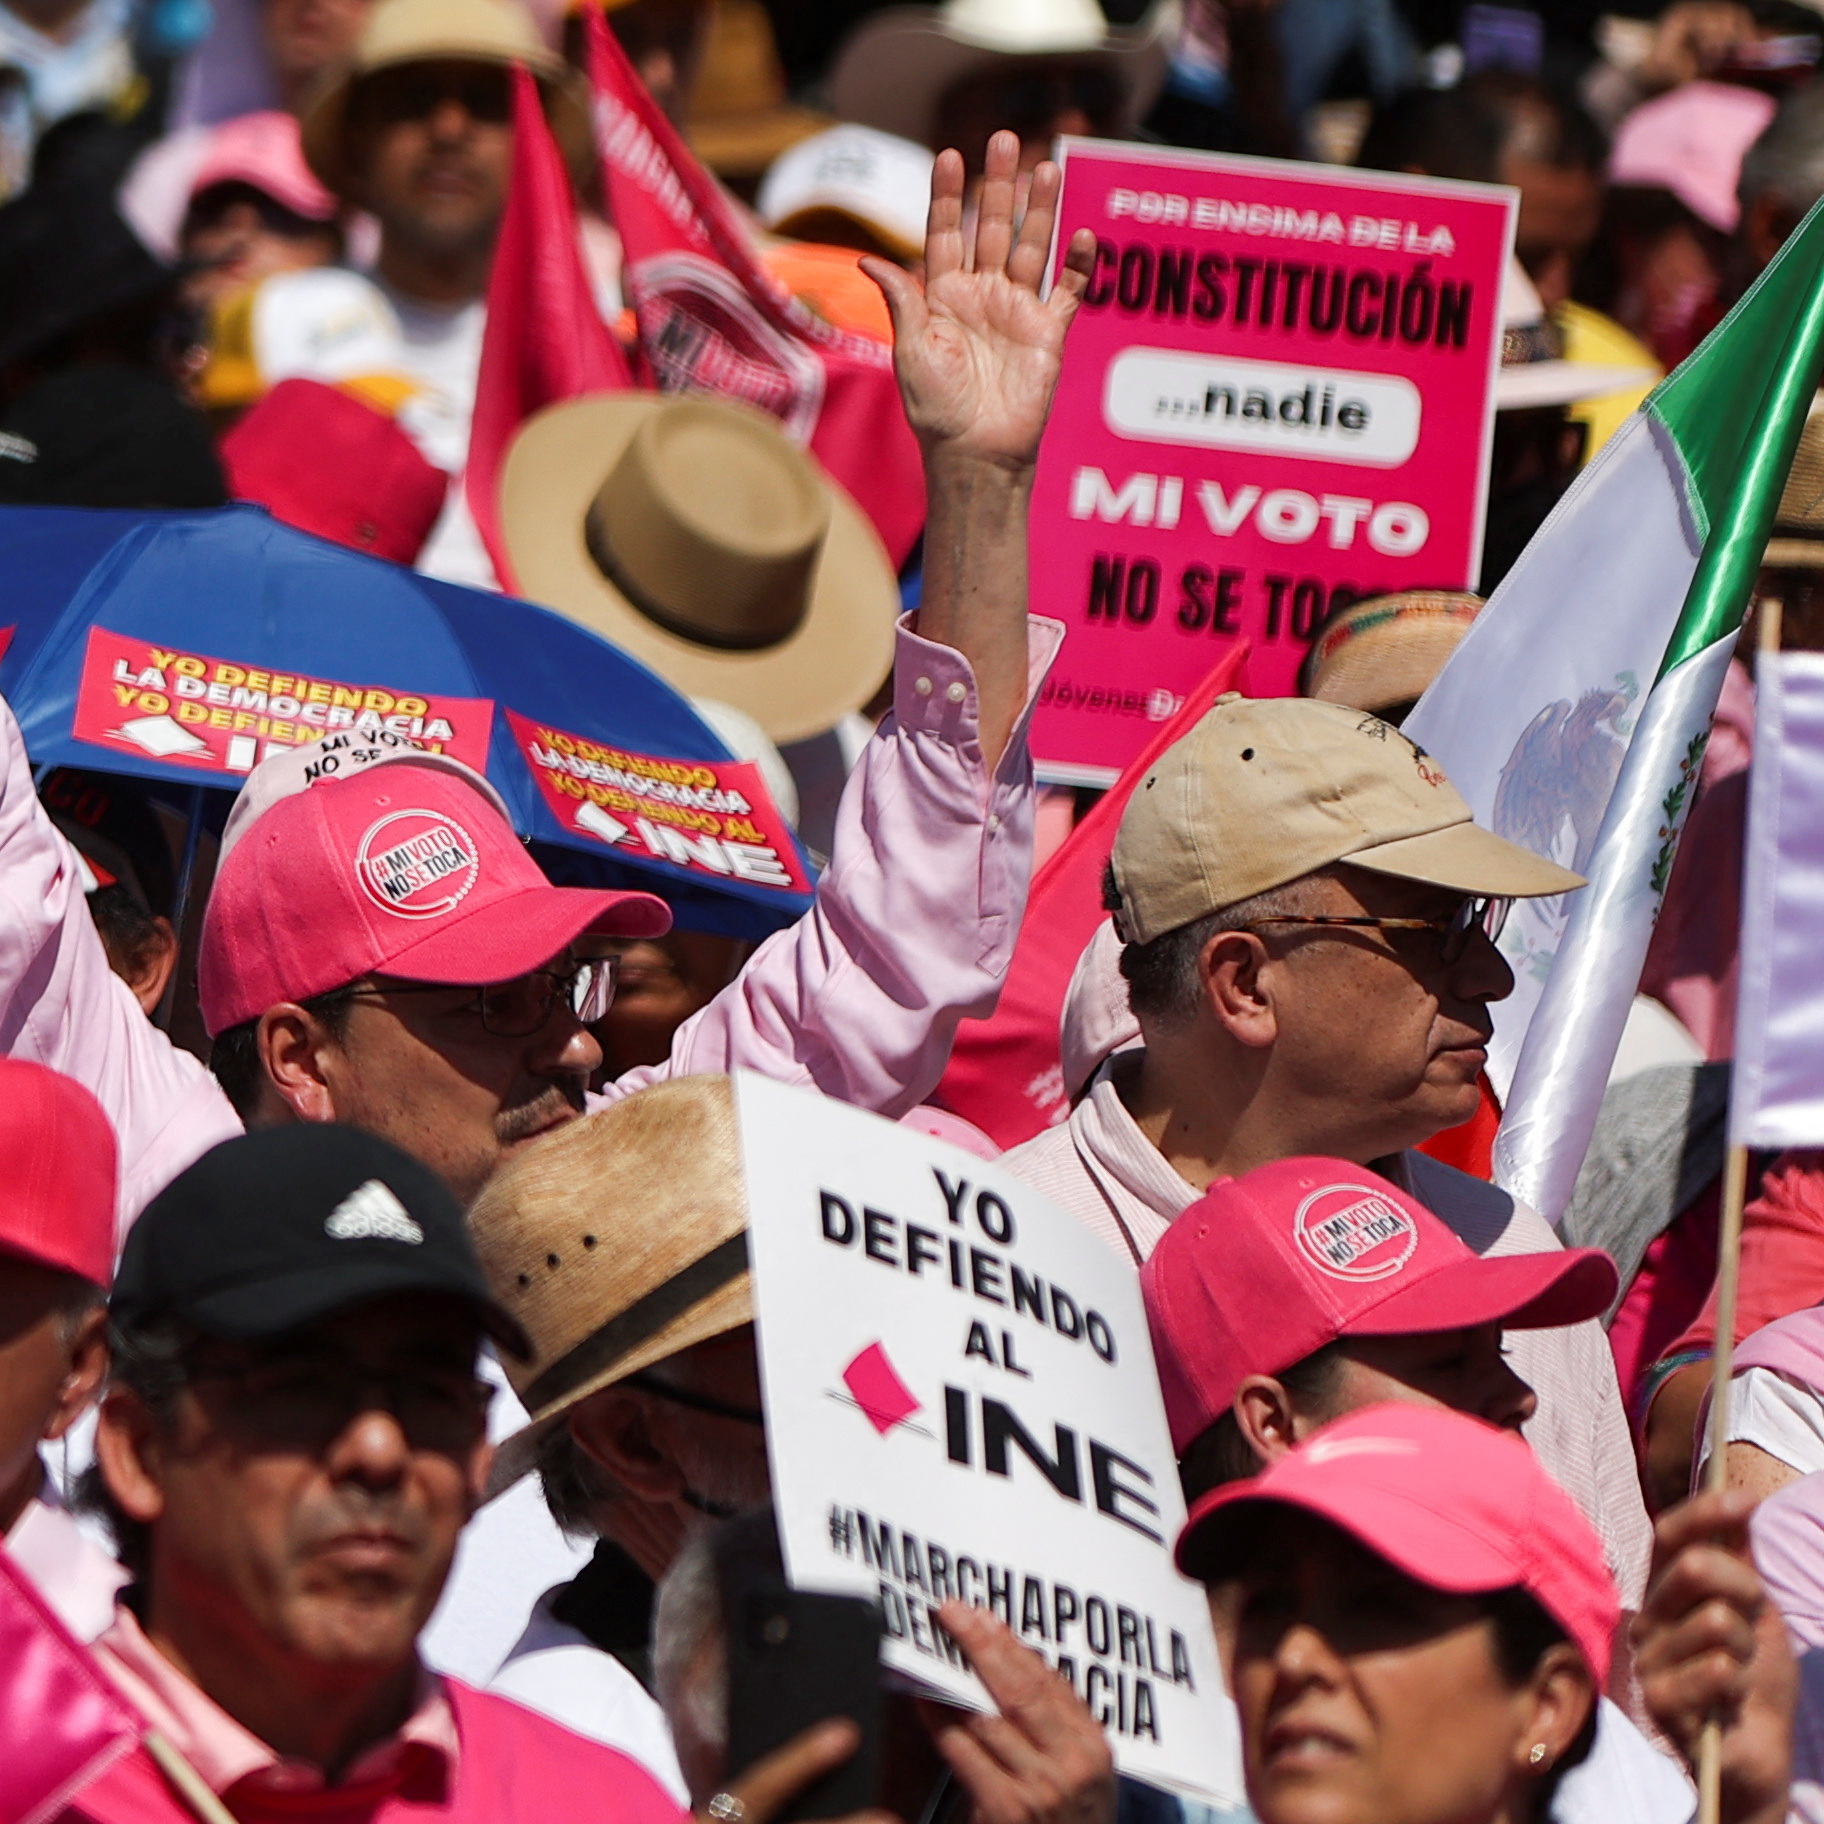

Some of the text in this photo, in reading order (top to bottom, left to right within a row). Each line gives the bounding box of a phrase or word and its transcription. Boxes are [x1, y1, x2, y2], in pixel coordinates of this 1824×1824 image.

[1081, 239, 1473, 350] CONSTITUCIÓN
[1068, 466, 1430, 556] MI VOTO
[1086, 551, 1163, 629] NO
[1176, 564, 1243, 636] SE
[112, 659, 454, 742] LA DEMOCRACIA
[112, 682, 326, 744] YO DEFIEN
[150, 648, 430, 717] YO DEFIENDO
[304, 754, 340, 784] NO
[528, 741, 752, 815] LA DEMOCRACIA
[576, 738, 718, 789] DEFIENDO
[585, 782, 722, 836] DEFIENDO
[633, 816, 793, 888] INE
[932, 1166, 1016, 1245] YO
[816, 1186, 1119, 1367] DEFIENDO
[963, 1320, 1032, 1381] AL
[942, 1382, 1169, 1550] INE
[827, 1501, 1196, 1696] #MARCHAPORLA
